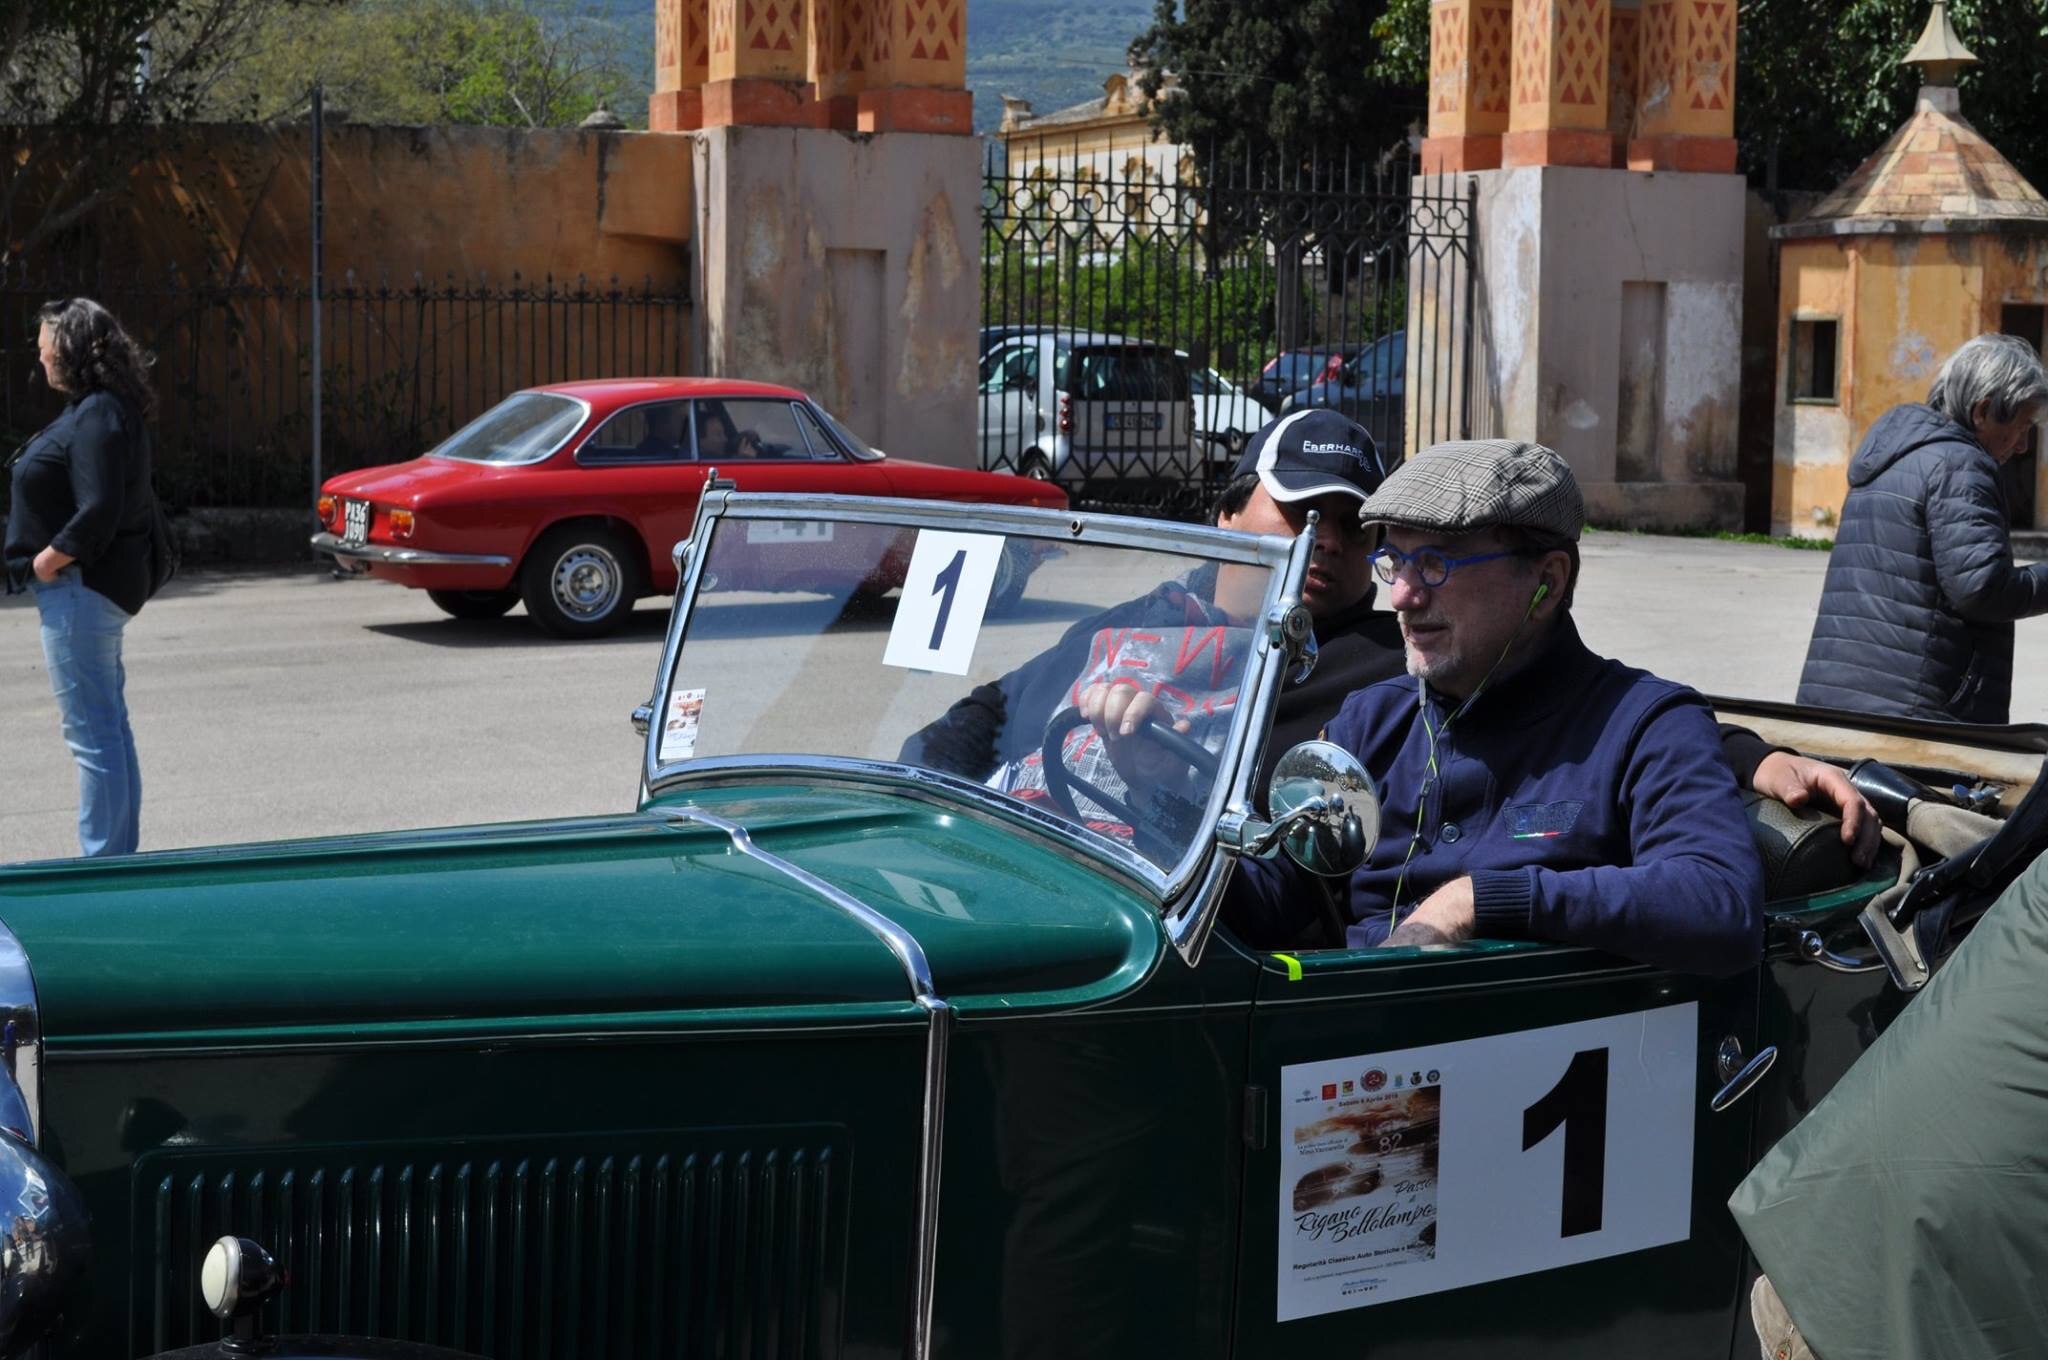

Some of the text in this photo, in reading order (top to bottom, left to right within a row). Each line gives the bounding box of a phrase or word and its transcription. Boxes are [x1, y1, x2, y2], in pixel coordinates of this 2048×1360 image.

[929, 550, 967, 651] 1
[1379, 1133, 1402, 1153] 82
[1521, 1046, 1609, 1238] 1
[1393, 1178, 1432, 1195] Passo
[1294, 1206, 1361, 1240] Rigano
[1327, 1202, 1433, 1243] Bellolampo
[1357, 1251, 1372, 1259] Auto
